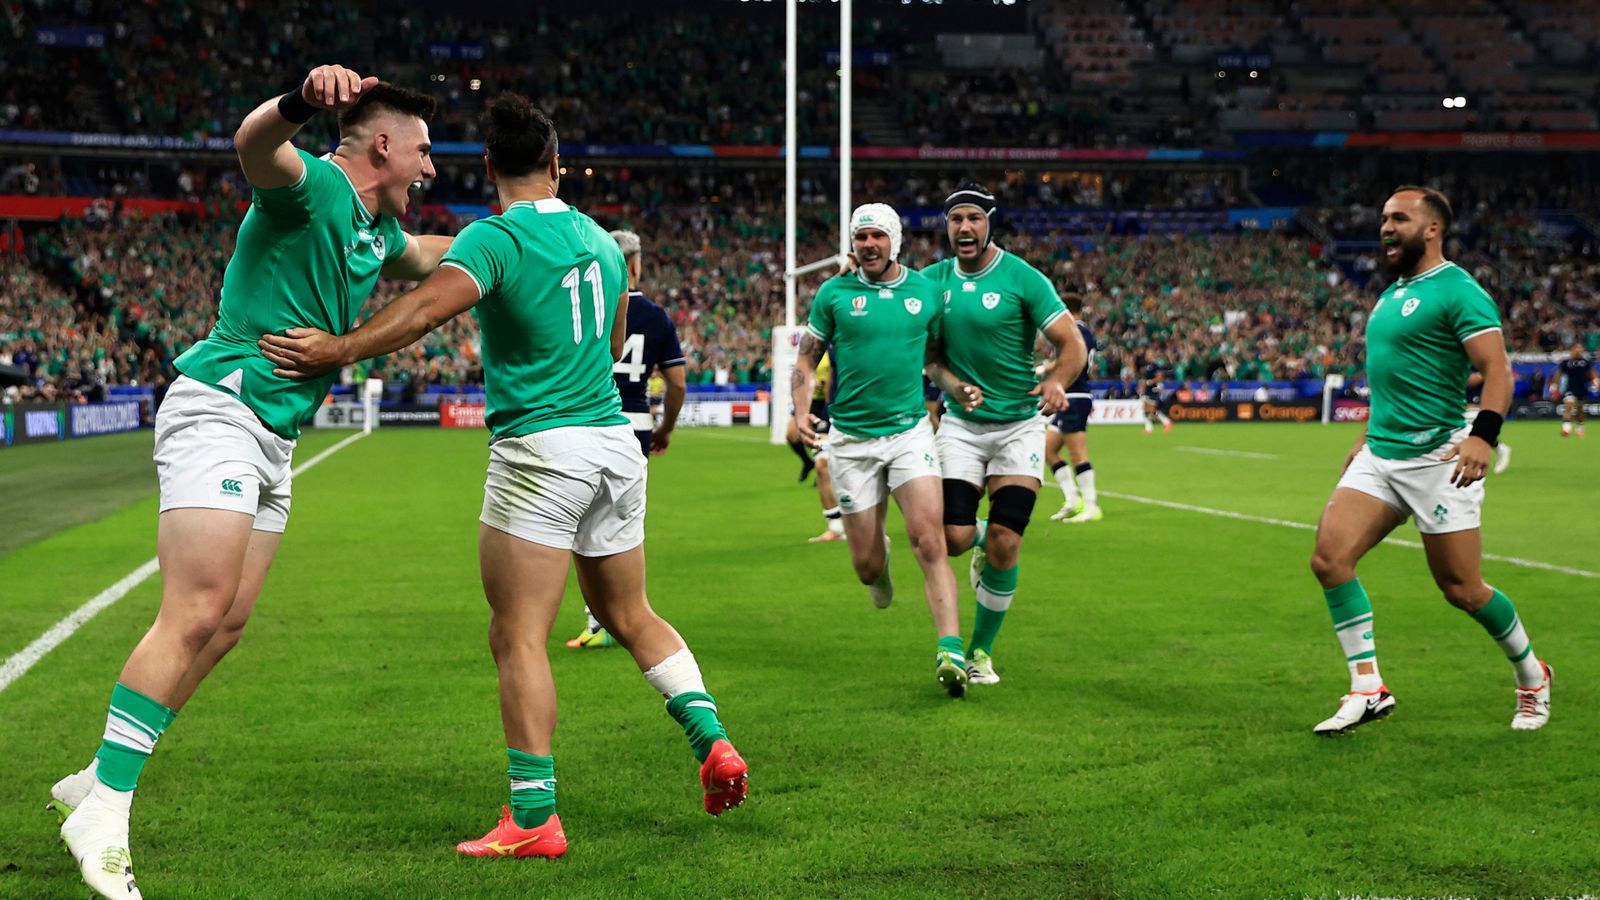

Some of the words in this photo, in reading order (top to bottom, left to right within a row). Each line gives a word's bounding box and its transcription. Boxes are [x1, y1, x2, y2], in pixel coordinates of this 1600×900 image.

[561, 260, 605, 345] 11
[1103, 407, 1137, 418] TRY
[1169, 404, 1228, 422] Orange
[1259, 404, 1317, 422] Orange
